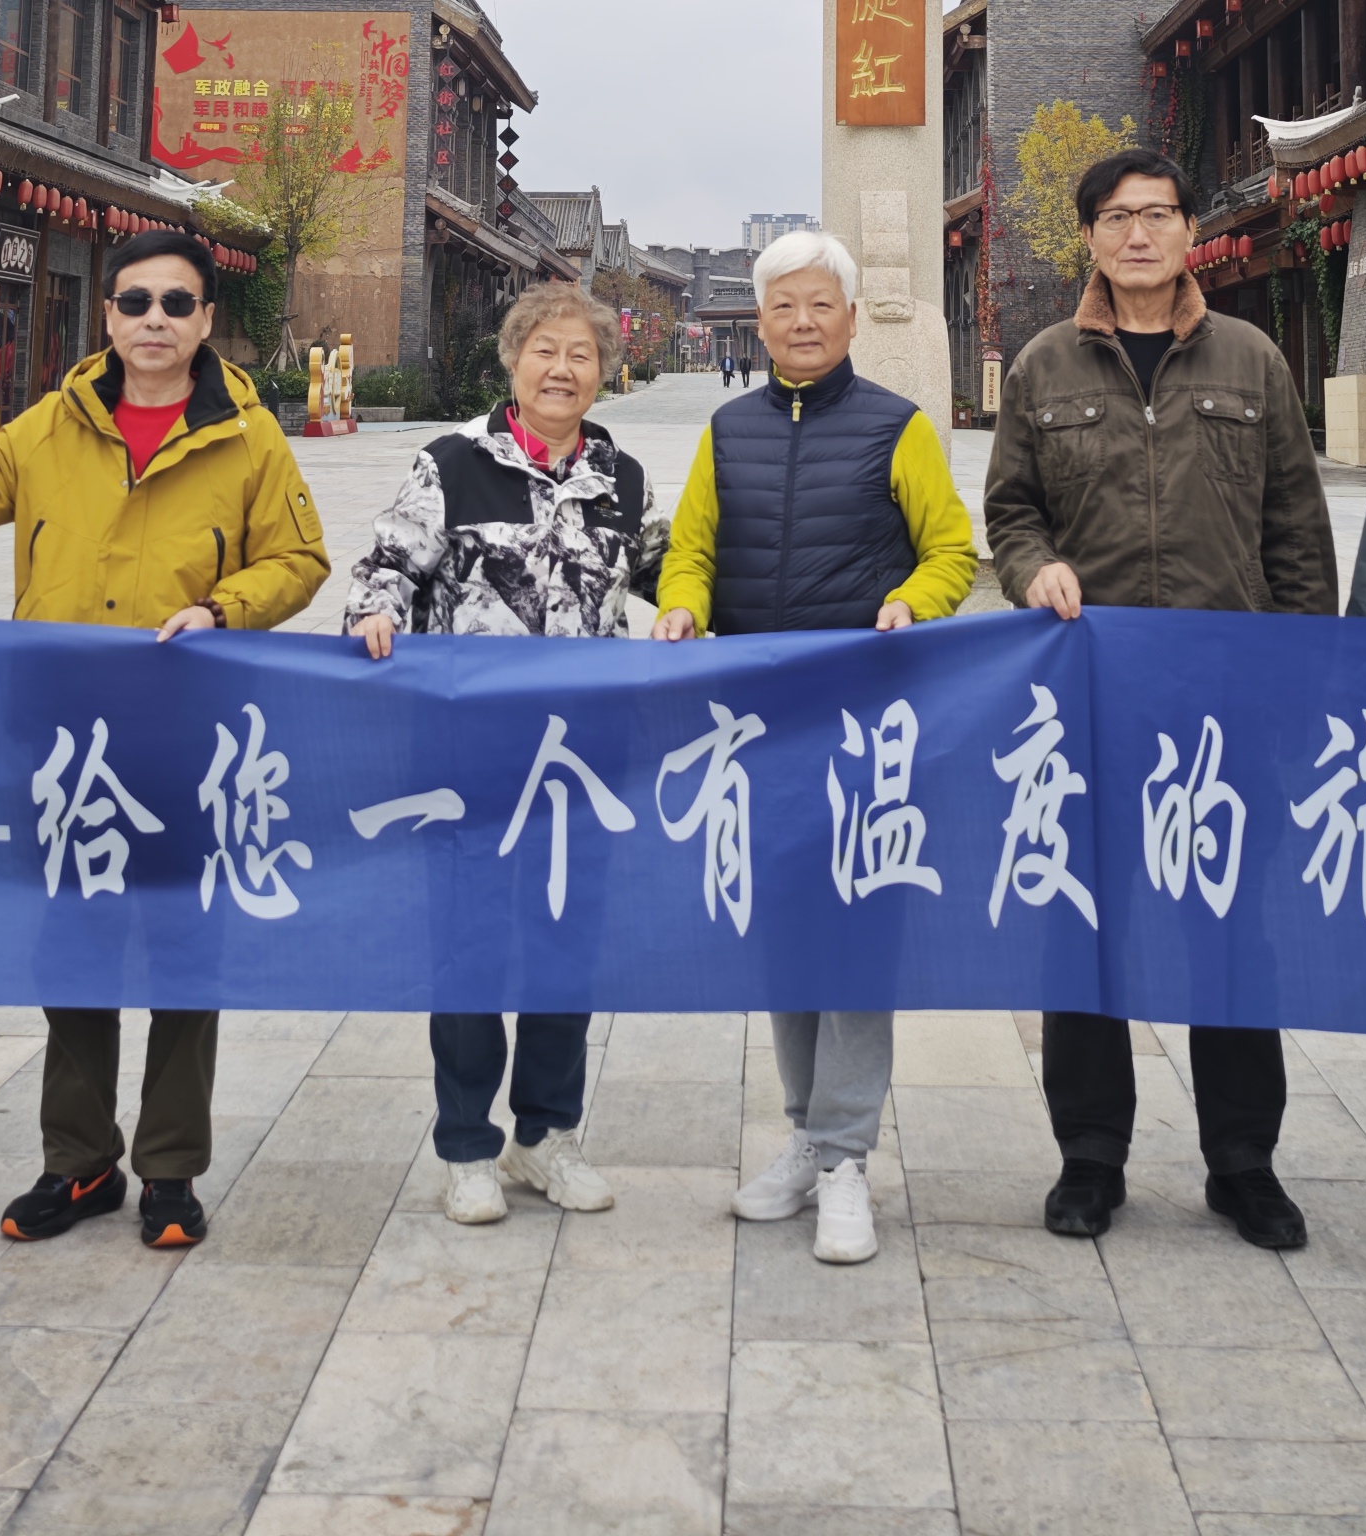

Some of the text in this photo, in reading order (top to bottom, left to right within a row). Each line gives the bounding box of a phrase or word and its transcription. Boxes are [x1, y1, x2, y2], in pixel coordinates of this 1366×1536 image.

[194, 79, 270, 97] 军政融合
[193, 100, 269, 118] 军民和睦
[436, 63, 455, 165] 红街社区
